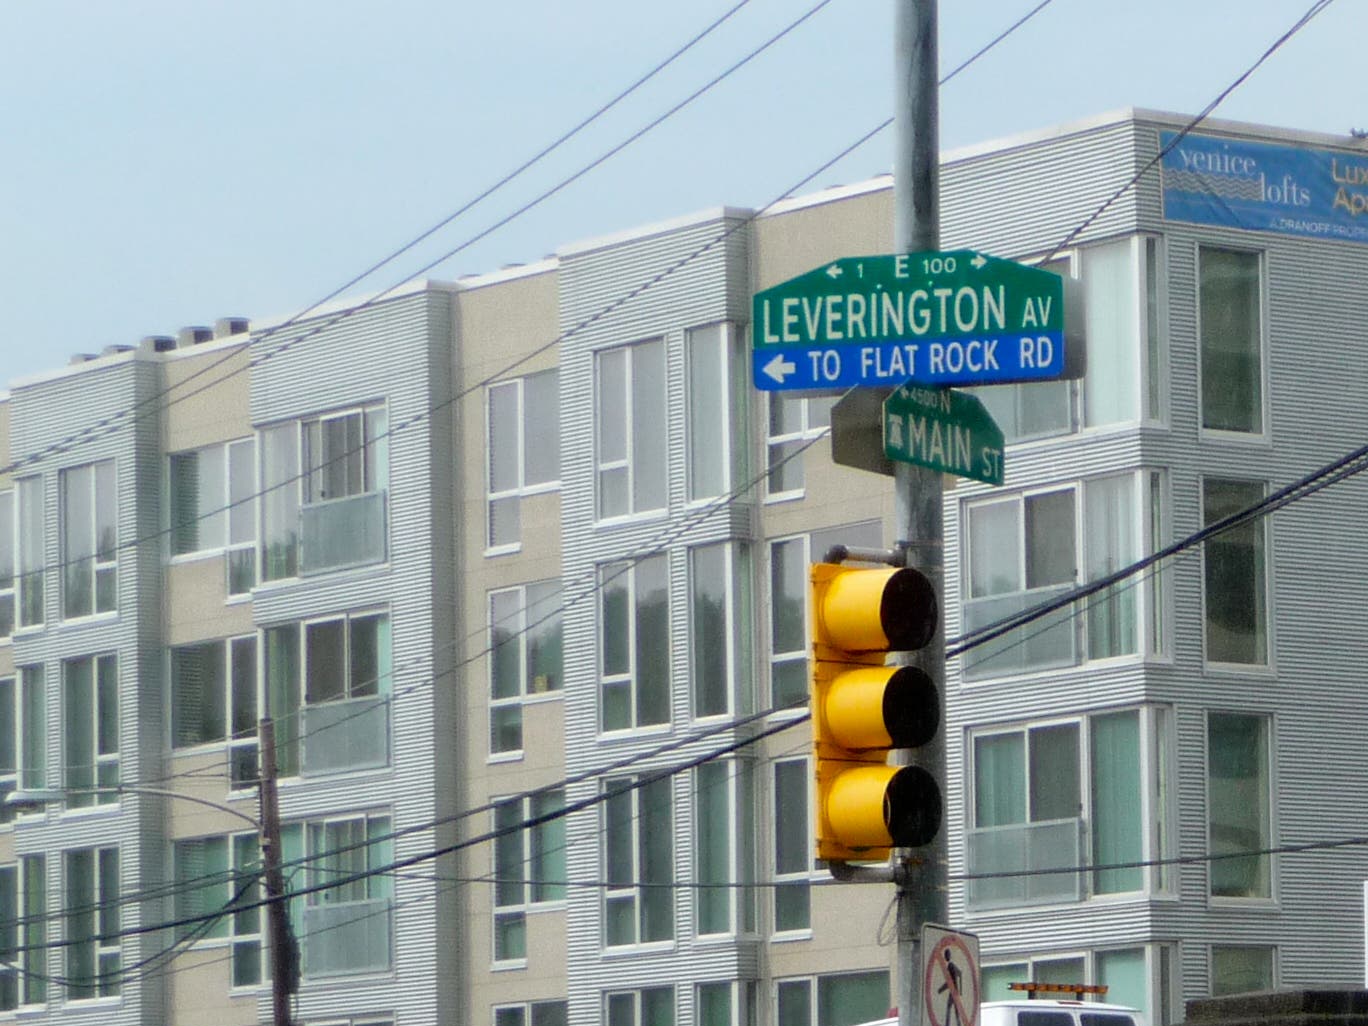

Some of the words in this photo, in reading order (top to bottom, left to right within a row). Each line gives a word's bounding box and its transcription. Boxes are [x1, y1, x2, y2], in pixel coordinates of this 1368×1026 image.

[1180, 144, 1257, 176] venice
[1260, 172, 1311, 207] lofts
[857, 263, 863, 278] 1
[895, 255, 909, 278] E
[924, 257, 957, 275] 100
[763, 285, 1006, 344] LEVERINGTON
[1022, 296, 1052, 328] AV
[808, 349, 841, 382] TO
[861, 344, 918, 379] FLAT
[930, 340, 1000, 374] ROCK
[1020, 336, 1053, 369] RD
[940, 390, 951, 414] N
[909, 413, 971, 472] MAIN
[982, 447, 1001, 479] ST
